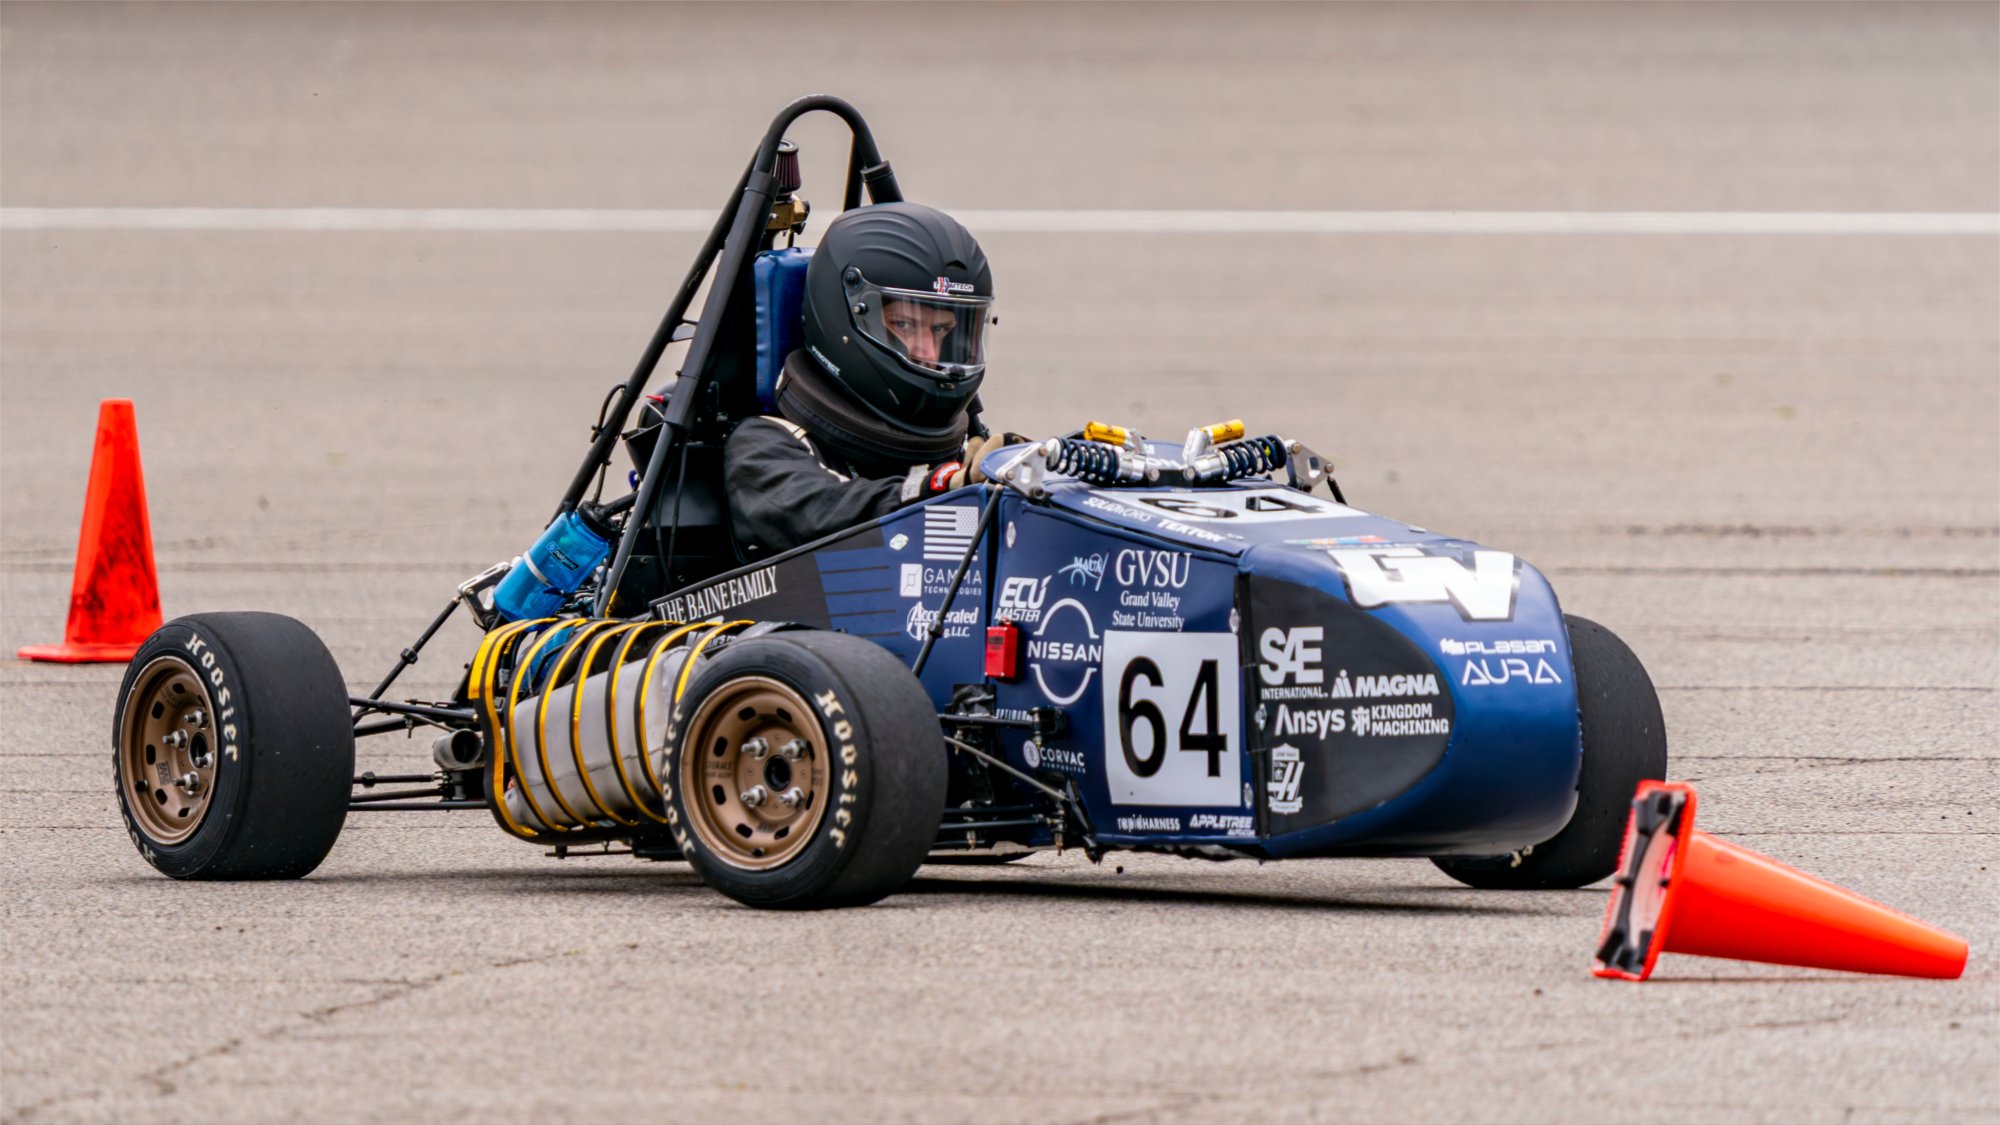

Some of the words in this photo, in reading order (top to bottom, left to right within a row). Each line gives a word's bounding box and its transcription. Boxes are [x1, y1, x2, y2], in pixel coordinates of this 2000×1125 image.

[1138, 496, 1325, 519] 64
[1157, 518, 1226, 543] TEKTON
[1115, 549, 1192, 588] GVSU
[656, 597, 687, 625] THE
[685, 582, 730, 621] BAINE
[727, 565, 778, 607] FAMILY
[924, 586, 982, 596] TECHNOGIES
[999, 574, 1053, 609] ECU
[1327, 548, 1517, 621] GV
[1120, 590, 1149, 607] Grand
[1152, 591, 1181, 612] Valley
[994, 608, 1041, 622] MASTER
[1112, 610, 1136, 627] State
[1137, 611, 1185, 632] University
[1027, 641, 1102, 662] NISSAN
[1259, 626, 1324, 686] SAE
[1462, 658, 1562, 685] AURA
[184, 633, 239, 763] Hoosier
[1262, 687, 1323, 700] INTERNATIONAL
[1355, 674, 1440, 698] MAGNA
[1118, 654, 1229, 778] 64
[1274, 704, 1346, 740] Ansys
[1371, 703, 1433, 720] KINGDOM
[1371, 718, 1450, 737] MACHINING
[815, 689, 858, 848] Hoosier
[1040, 747, 1085, 767] CORVAC
[1189, 814, 1253, 829] APPLETREE
